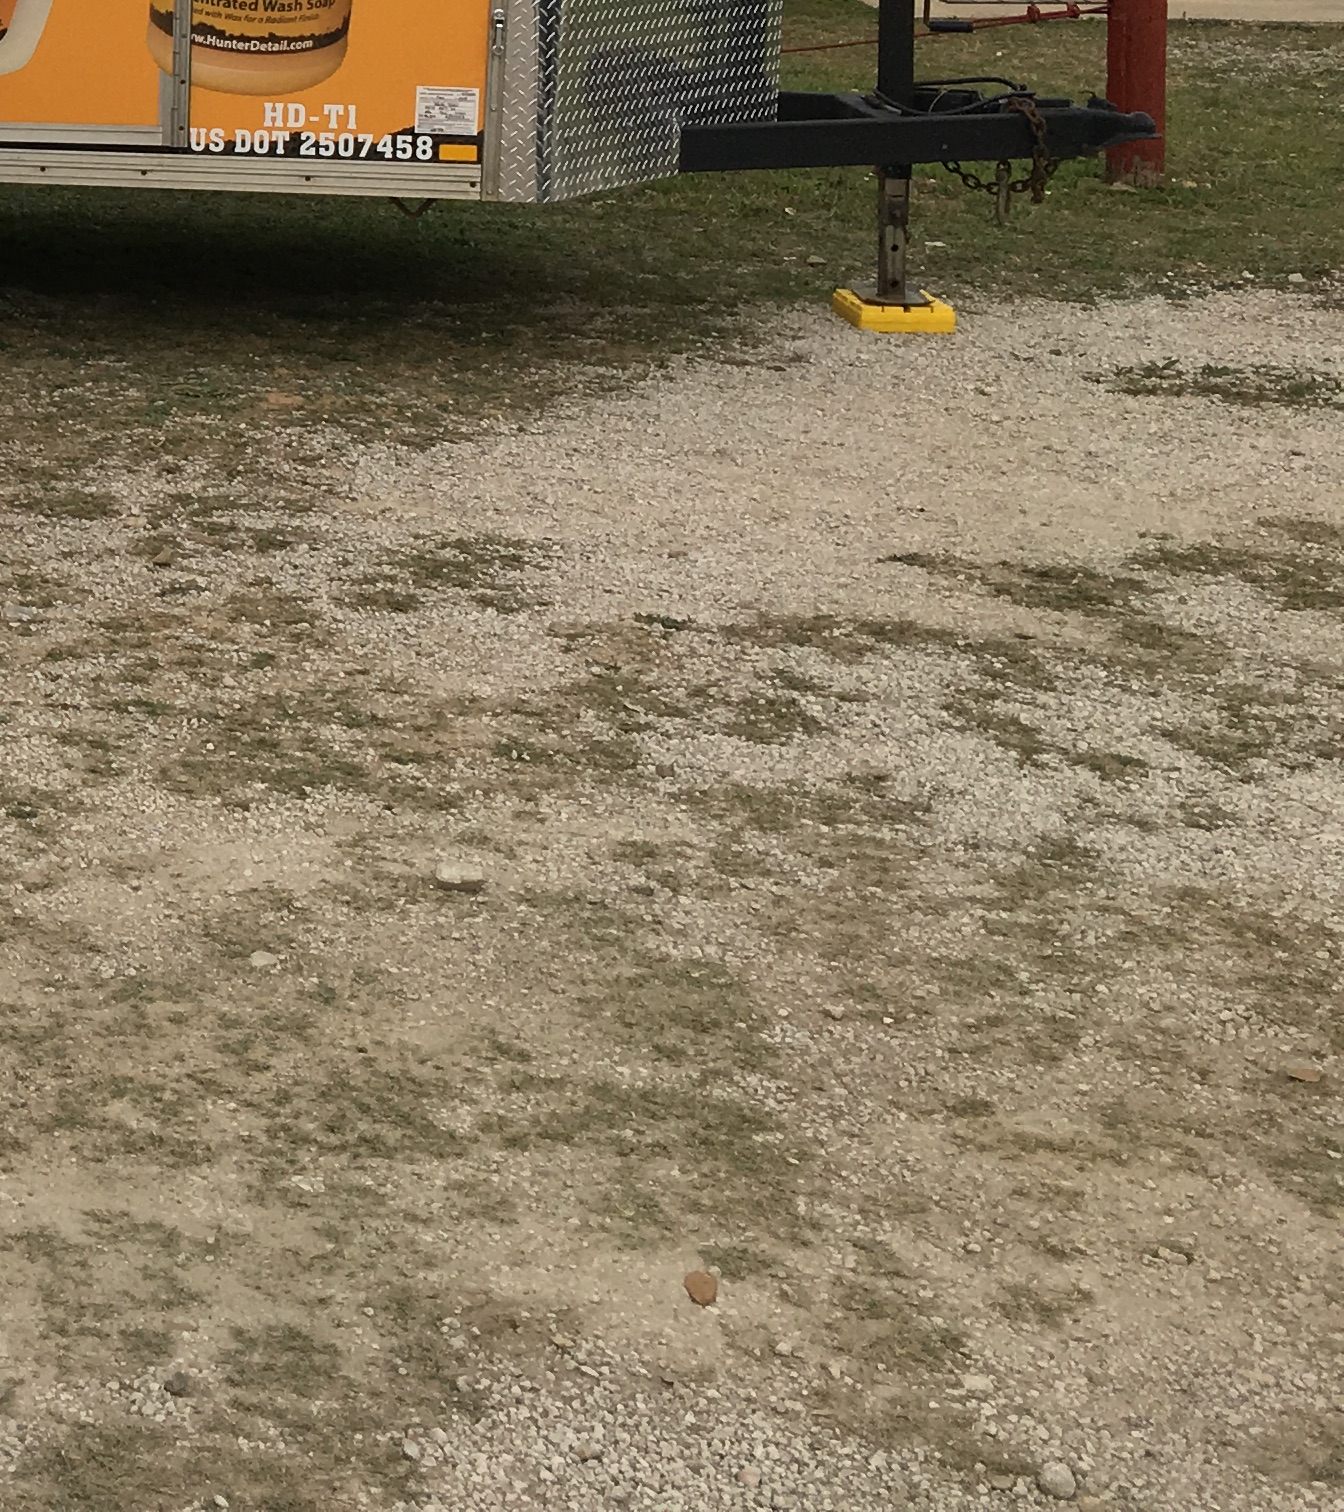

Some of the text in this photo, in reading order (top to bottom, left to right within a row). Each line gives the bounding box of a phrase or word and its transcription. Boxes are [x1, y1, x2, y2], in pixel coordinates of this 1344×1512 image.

[191, 32, 314, 53] w.HunterDetail.com
[189, 127, 434, 161] US DOT 2507458
